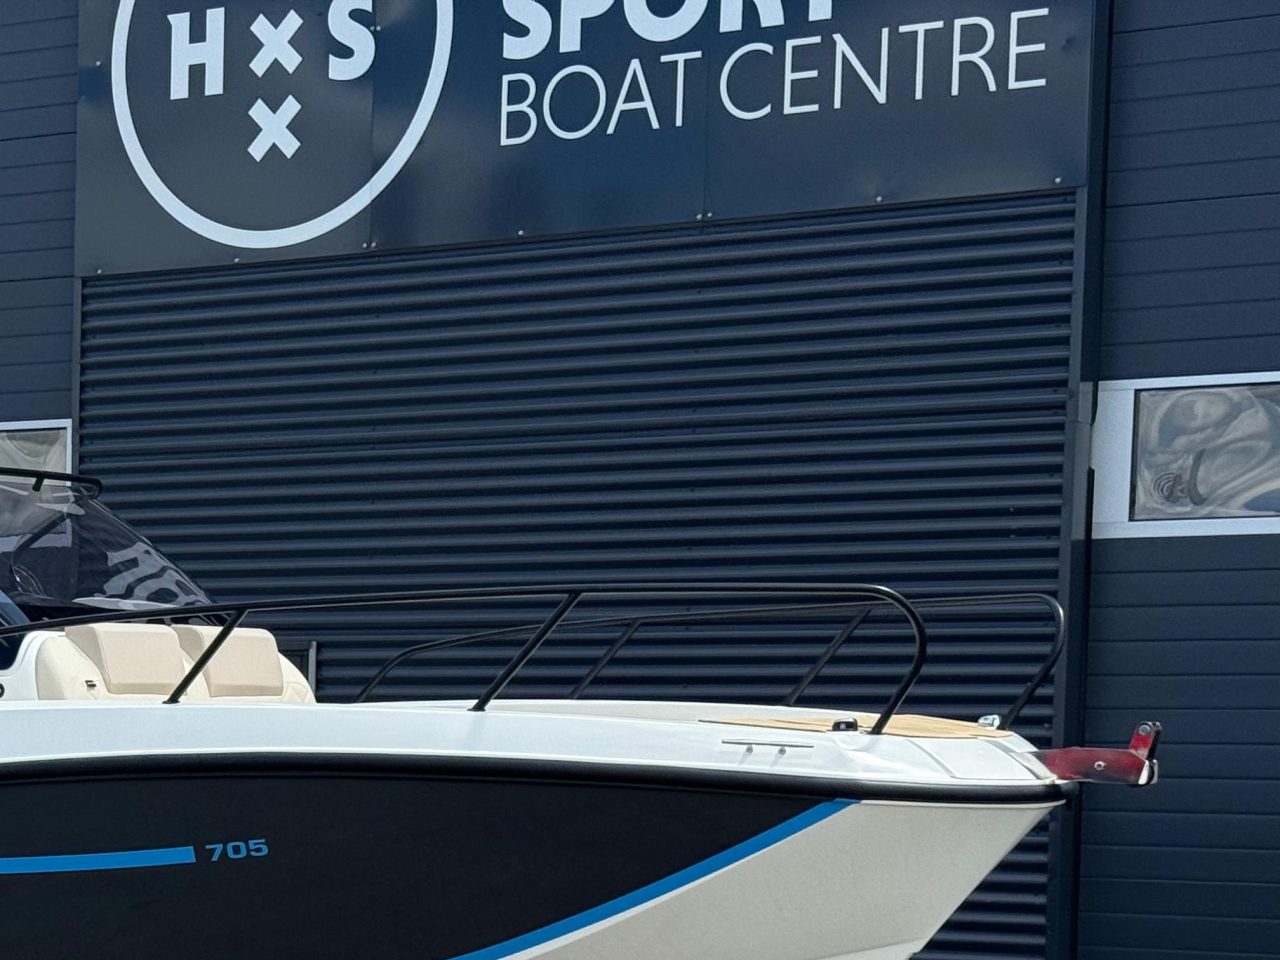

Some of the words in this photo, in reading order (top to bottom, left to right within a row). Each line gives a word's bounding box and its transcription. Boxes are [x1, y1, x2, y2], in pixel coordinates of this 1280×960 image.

[502, 0, 834, 60] SPO
[500, 50, 702, 146] BOAT
[719, 7, 1049, 120] CENTRE
[205, 838, 269, 862] 705
